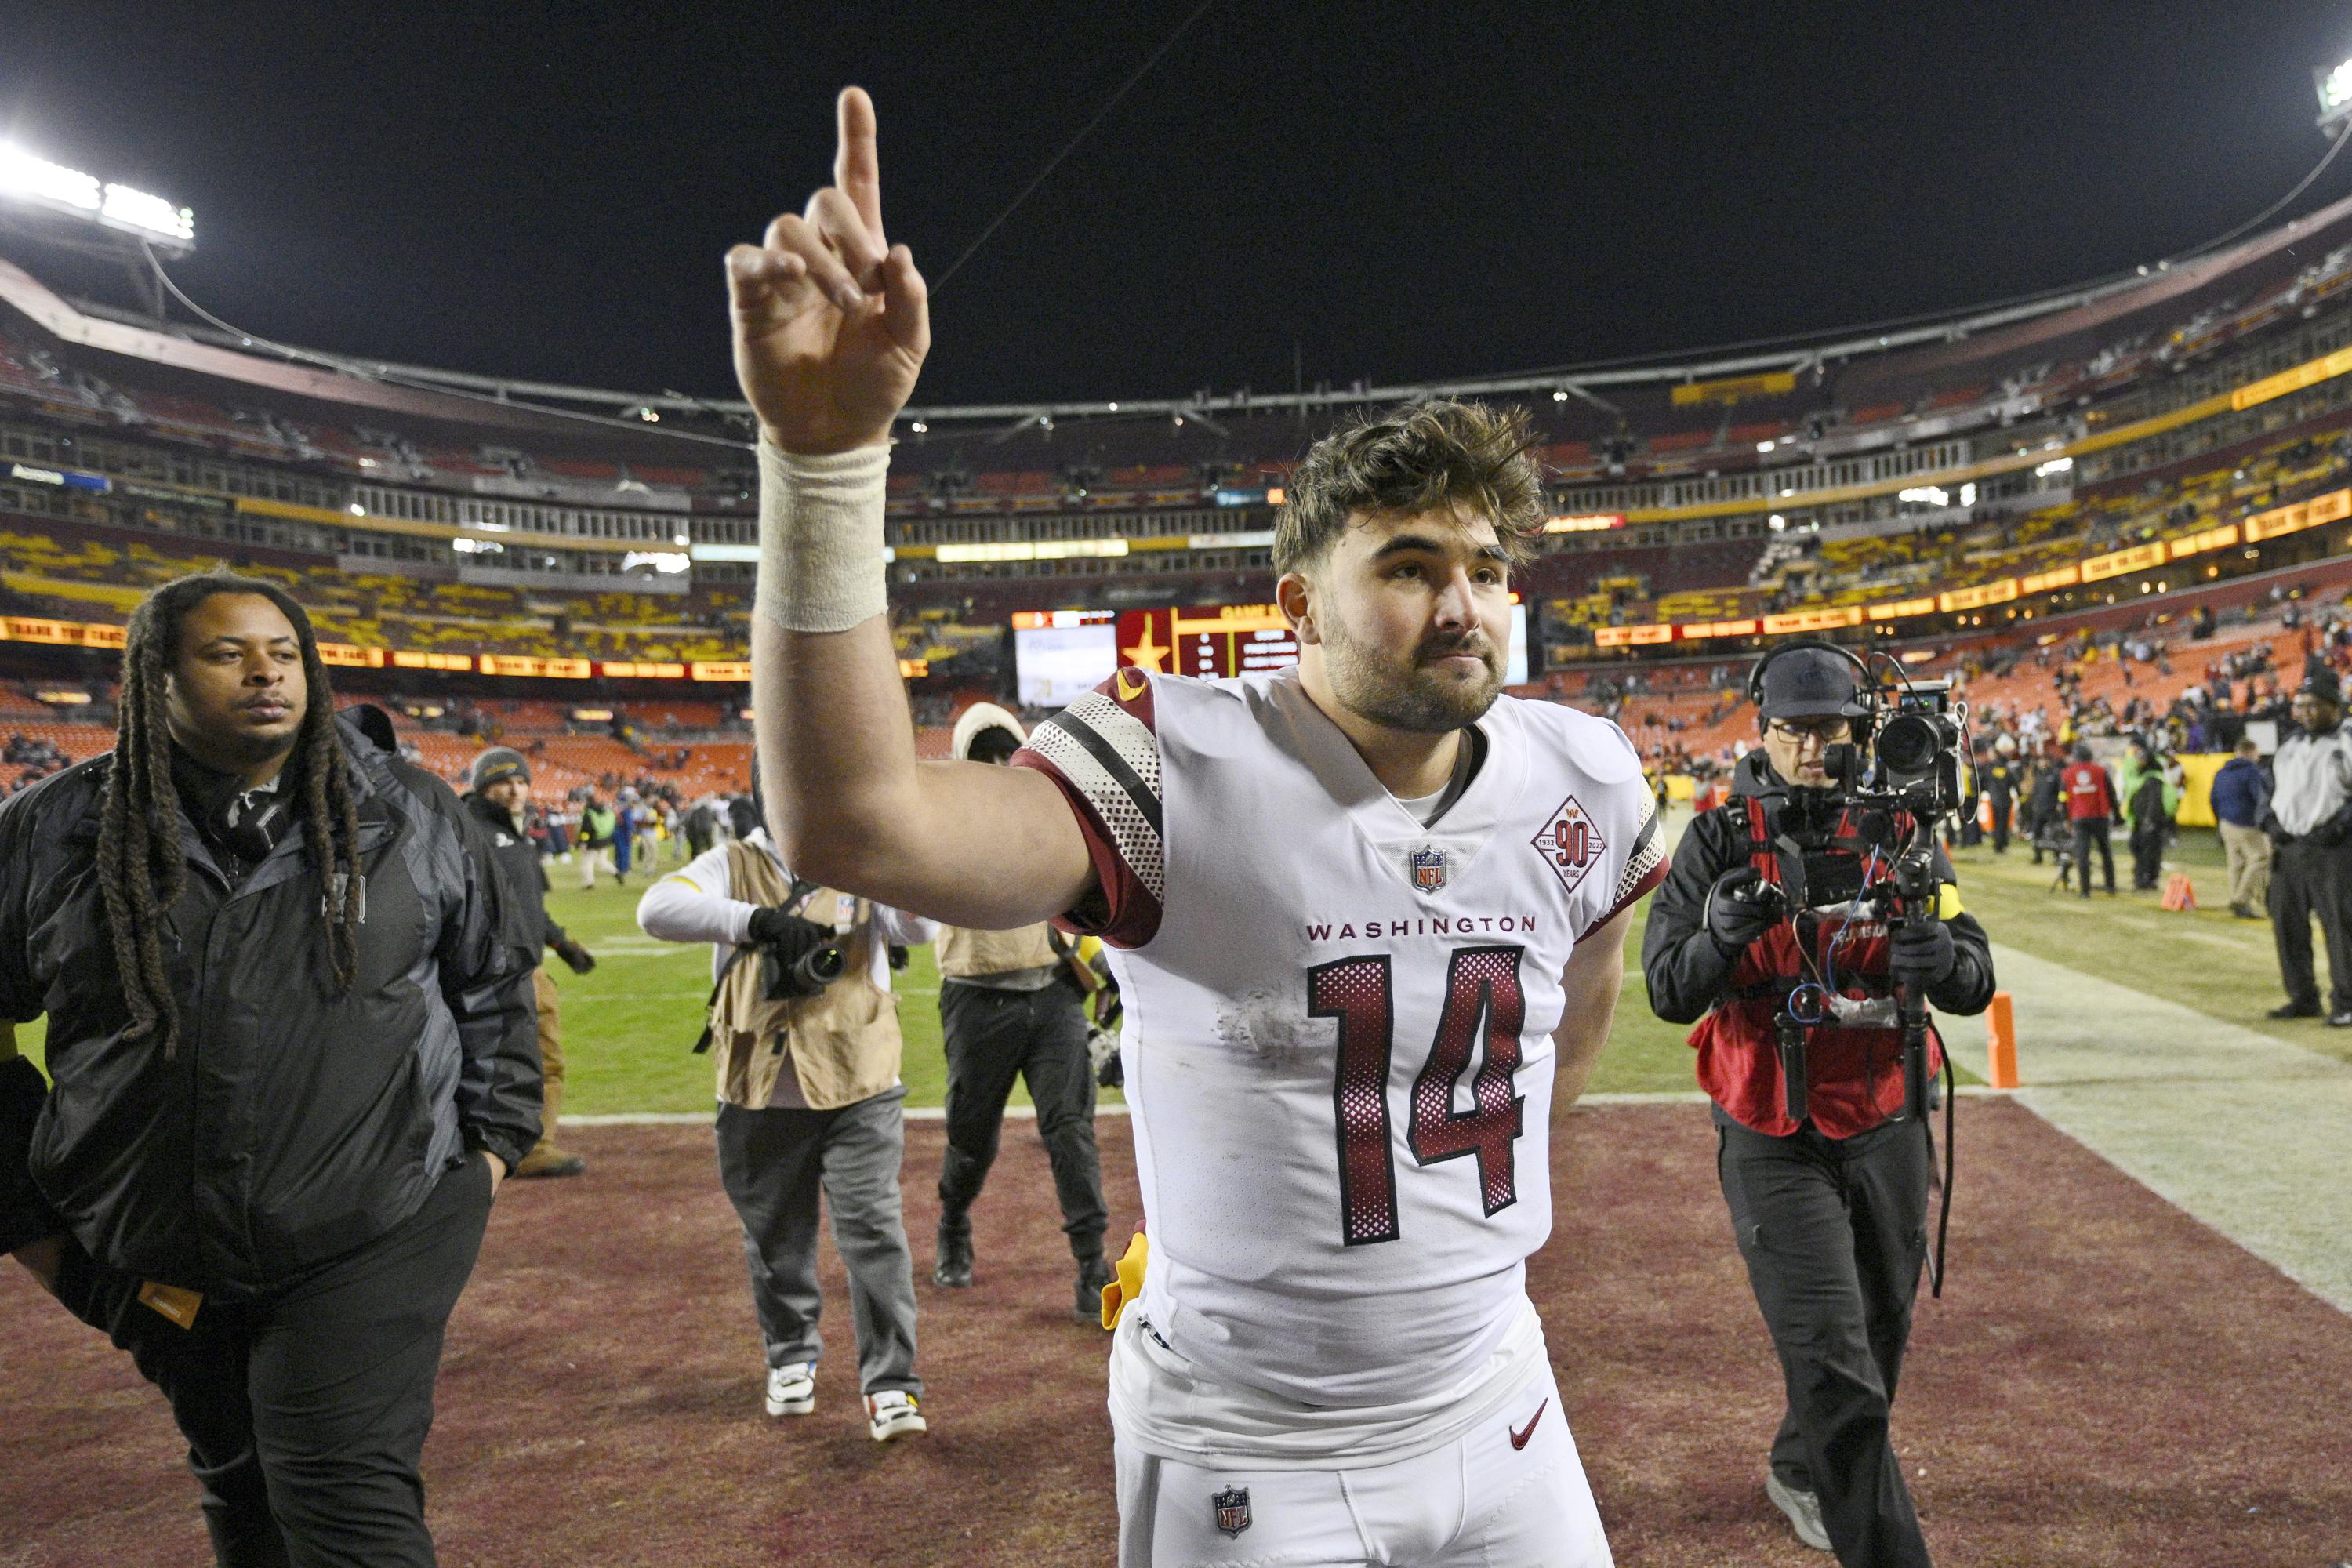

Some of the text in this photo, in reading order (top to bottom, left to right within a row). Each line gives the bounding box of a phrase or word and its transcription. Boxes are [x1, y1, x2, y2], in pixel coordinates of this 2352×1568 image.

[1555, 820, 1589, 868] 90
[1418, 867, 1443, 886] NFL
[1563, 869, 1580, 879] YEARS
[1306, 916, 1536, 941] WASHINGTON
[1307, 945, 1525, 1247] 14
[1220, 1506, 1247, 1528] NFL
